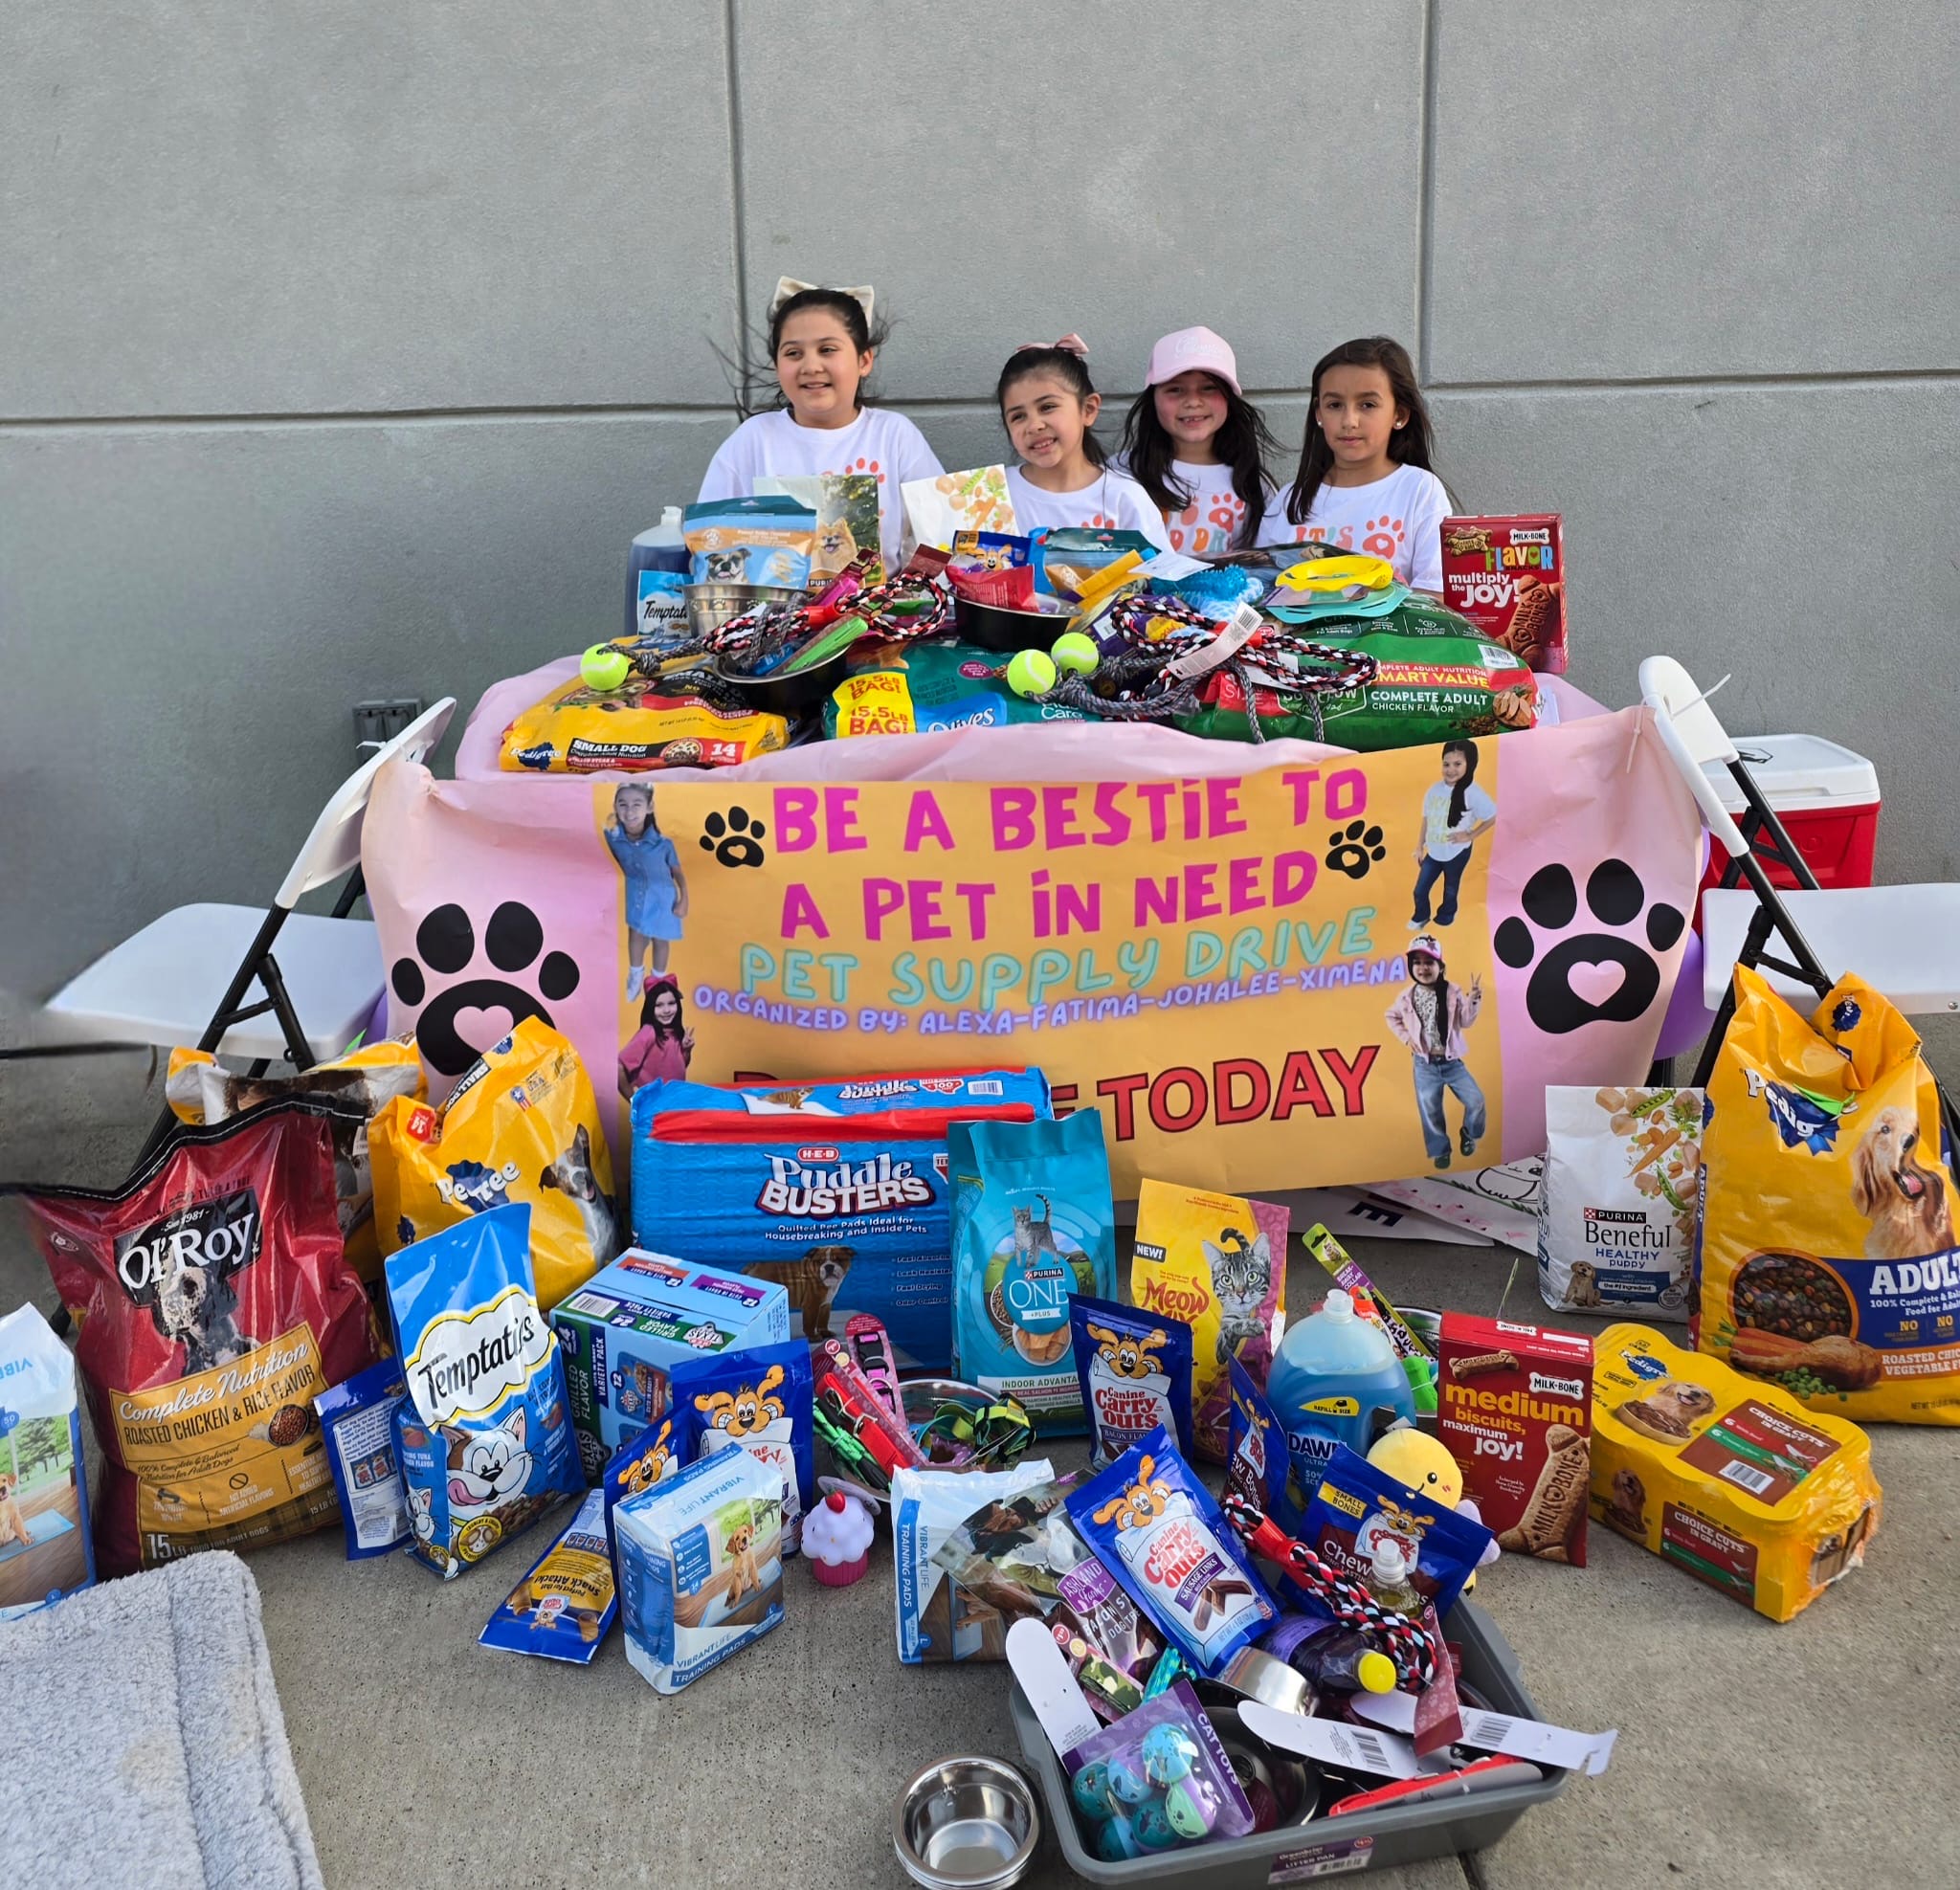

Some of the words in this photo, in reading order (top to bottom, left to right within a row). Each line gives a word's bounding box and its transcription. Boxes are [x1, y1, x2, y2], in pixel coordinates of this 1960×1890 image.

[1485, 545, 1554, 571] FLAVOR
[1448, 572, 1510, 587] multiply
[1451, 584, 1465, 592] the
[1414, 665, 1438, 674] ADULT
[1442, 666, 1486, 678] NUTRITION
[1436, 673, 1489, 688] VALUE
[851, 681, 901, 700] BAG!
[1371, 691, 1439, 703] COMPLETE
[1443, 691, 1488, 705] ADULT
[1040, 707, 1083, 720] Care
[1371, 702, 1414, 713] CHICKEN
[1418, 703, 1454, 714] FLAVOR
[849, 717, 908, 734] BAG!
[510, 747, 563, 760] Pedigree
[573, 739, 617, 753] SMALL
[620, 745, 647, 753] DOG
[711, 743, 736, 756] 14
[773, 787, 868, 854] BE
[903, 789, 956, 852] A
[1282, 767, 1368, 827] TO
[780, 883, 831, 939] A
[862, 878, 996, 943] PET
[1134, 850, 1318, 928] NEED
[740, 942, 859, 1003] PET
[1185, 905, 1376, 980] DRIVE
[694, 986, 848, 1031] ORGANIZED
[858, 1009, 908, 1034] BY:
[1098, 1045, 1380, 1142] TODAY
[764, 1152, 913, 1190] Puddle
[760, 1177, 932, 1215] BUSTERS
[1698, 1167, 1706, 1223] ADULT
[778, 1222, 816, 1233] Quilted
[840, 1218, 866, 1229] Pads
[868, 1216, 896, 1226] Ideal
[898, 1214, 914, 1225] for
[1598, 1212, 1643, 1222] PURINA
[765, 1230, 843, 1242] Housebreaking
[846, 1227, 867, 1235] and
[870, 1224, 902, 1234] Inside
[905, 1224, 927, 1234] Pets
[1585, 1219, 1672, 1248] Beneful
[1136, 1244, 1164, 1260] NEW!
[1595, 1248, 1660, 1261] HEALTHY
[1033, 1269, 1063, 1278] PURINA
[1609, 1258, 1646, 1270] puppy
[1344, 1272, 1363, 1291] COLLAR
[1008, 1279, 1069, 1307] ONE
[1141, 1277, 1211, 1315] Meow
[1870, 1300, 1898, 1308] 100%
[1900, 1296, 1939, 1307] Complete
[1905, 1307, 1927, 1316] Food
[1927, 1304, 1940, 1314] for
[646, 1319, 681, 1332] FLAVOR
[1899, 1320, 1919, 1332] NO
[1937, 1314, 1954, 1327] NO
[641, 1324, 677, 1338] GRILLED
[688, 1326, 721, 1345] TEXAS
[596, 1337, 605, 1360] PACK
[1882, 1352, 1936, 1366] ROASTED
[1884, 1361, 1950, 1376] VEGETABLE
[120, 1382, 215, 1424] Complete
[217, 1342, 309, 1398] Nutrition
[596, 1363, 606, 1396] VARIETY
[612, 1373, 622, 1388] 12
[1001, 1380, 1036, 1389] INDOOR
[1533, 1377, 1581, 1396] MILK-BONE
[581, 1371, 591, 1420] FLAVOR
[1095, 1388, 1159, 1416] Carry
[1107, 1387, 1146, 1400] Canine
[1339, 1407, 1351, 1415] SIZE
[1445, 1382, 1585, 1427] medium
[4, 1414, 16, 1424] 50
[123, 1423, 172, 1446] ROASTED
[173, 1405, 230, 1440] CHICKEN
[233, 1407, 243, 1422] &
[243, 1390, 271, 1417] RICE
[1456, 1408, 1526, 1435] biscuits,
[1724, 1417, 1736, 1426] 6
[1748, 1407, 1792, 1434] CHOICE
[1793, 1430, 1827, 1448] CUTS
[1442, 1418, 1508, 1440] maximum
[1772, 1426, 1806, 1442] GRAVY
[201, 1444, 240, 1464] Balanced
[212, 1456, 234, 1471] Dogs
[1303, 1457, 1328, 1467] ULTRA
[701, 1476, 745, 1503] VIBRANT
[1246, 1467, 1262, 1511] Bones
[1532, 1501, 1557, 1536] MILK
[1557, 1454, 1584, 1490] BONE
[1332, 1497, 1360, 1516] BONES
[1334, 1490, 1362, 1509] SMALL
[1149, 1522, 1180, 1556] Canine
[1663, 1526, 1671, 1537] 6
[1674, 1511, 1715, 1538] CHOICE
[1715, 1531, 1745, 1554] CUTS
[1690, 1527, 1700, 1538] IN
[1700, 1534, 1729, 1554] GRAVY
[902, 1523, 911, 1582] TRAINING
[920, 1524, 928, 1567] VIBRANT
[1144, 1521, 1192, 1585] Carry
[1324, 1540, 1373, 1576] Chew
[921, 1567, 930, 1592] LIFE
[1063, 1562, 1102, 1598] ASHLAND
[1180, 1568, 1203, 1601] SAUSAGE
[1202, 1558, 1218, 1575] LINKS
[902, 1582, 912, 1608] PADS
[1108, 1620, 1126, 1639] DOG
[675, 1656, 721, 1682] TRAINING
[723, 1637, 746, 1657] PADS
[677, 1642, 715, 1668] VIBRANT
[1197, 1712, 1220, 1744] CAT
[1215, 1743, 1239, 1785] TOYS
